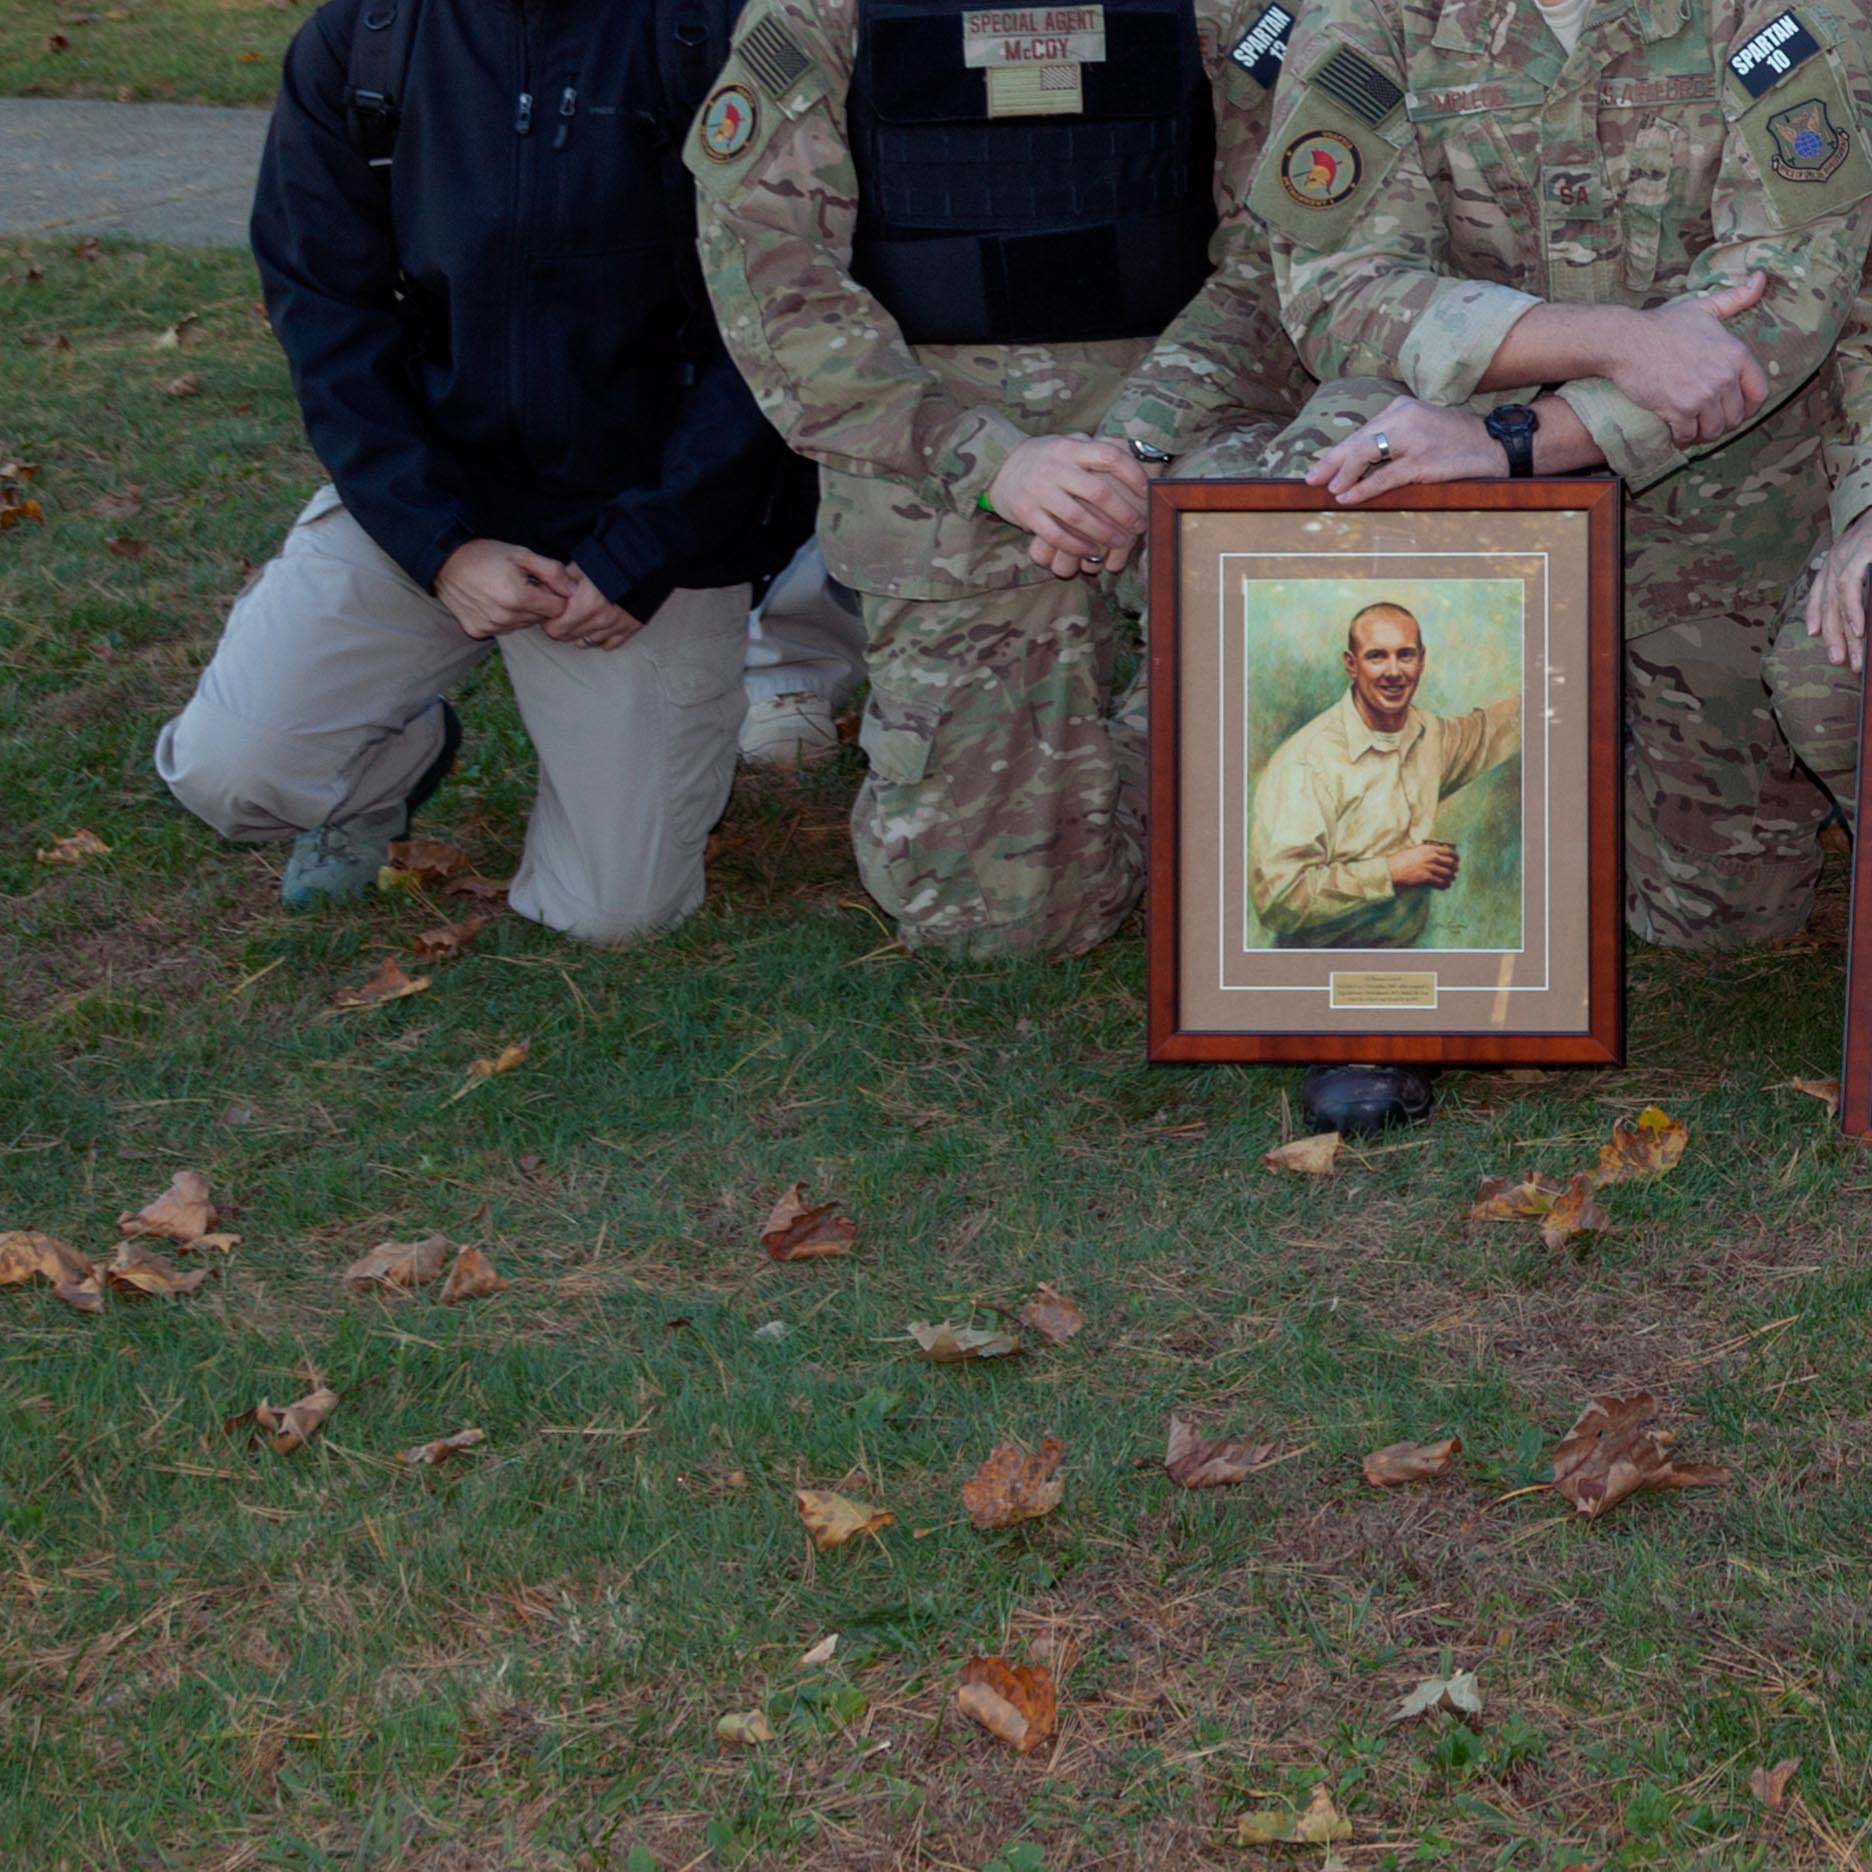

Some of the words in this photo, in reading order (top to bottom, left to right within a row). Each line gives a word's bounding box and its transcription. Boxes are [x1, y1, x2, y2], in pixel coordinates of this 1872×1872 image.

[969, 13, 1038, 34] SPECIAL
[1045, 9, 1095, 32] AGENT
[1004, 37, 1070, 61] McCOY
[1233, 5, 1291, 68] SPARTAN
[1731, 14, 1799, 76] SPARTAN
[1766, 48, 1791, 74] 10
[1560, 185, 1590, 205] SA
